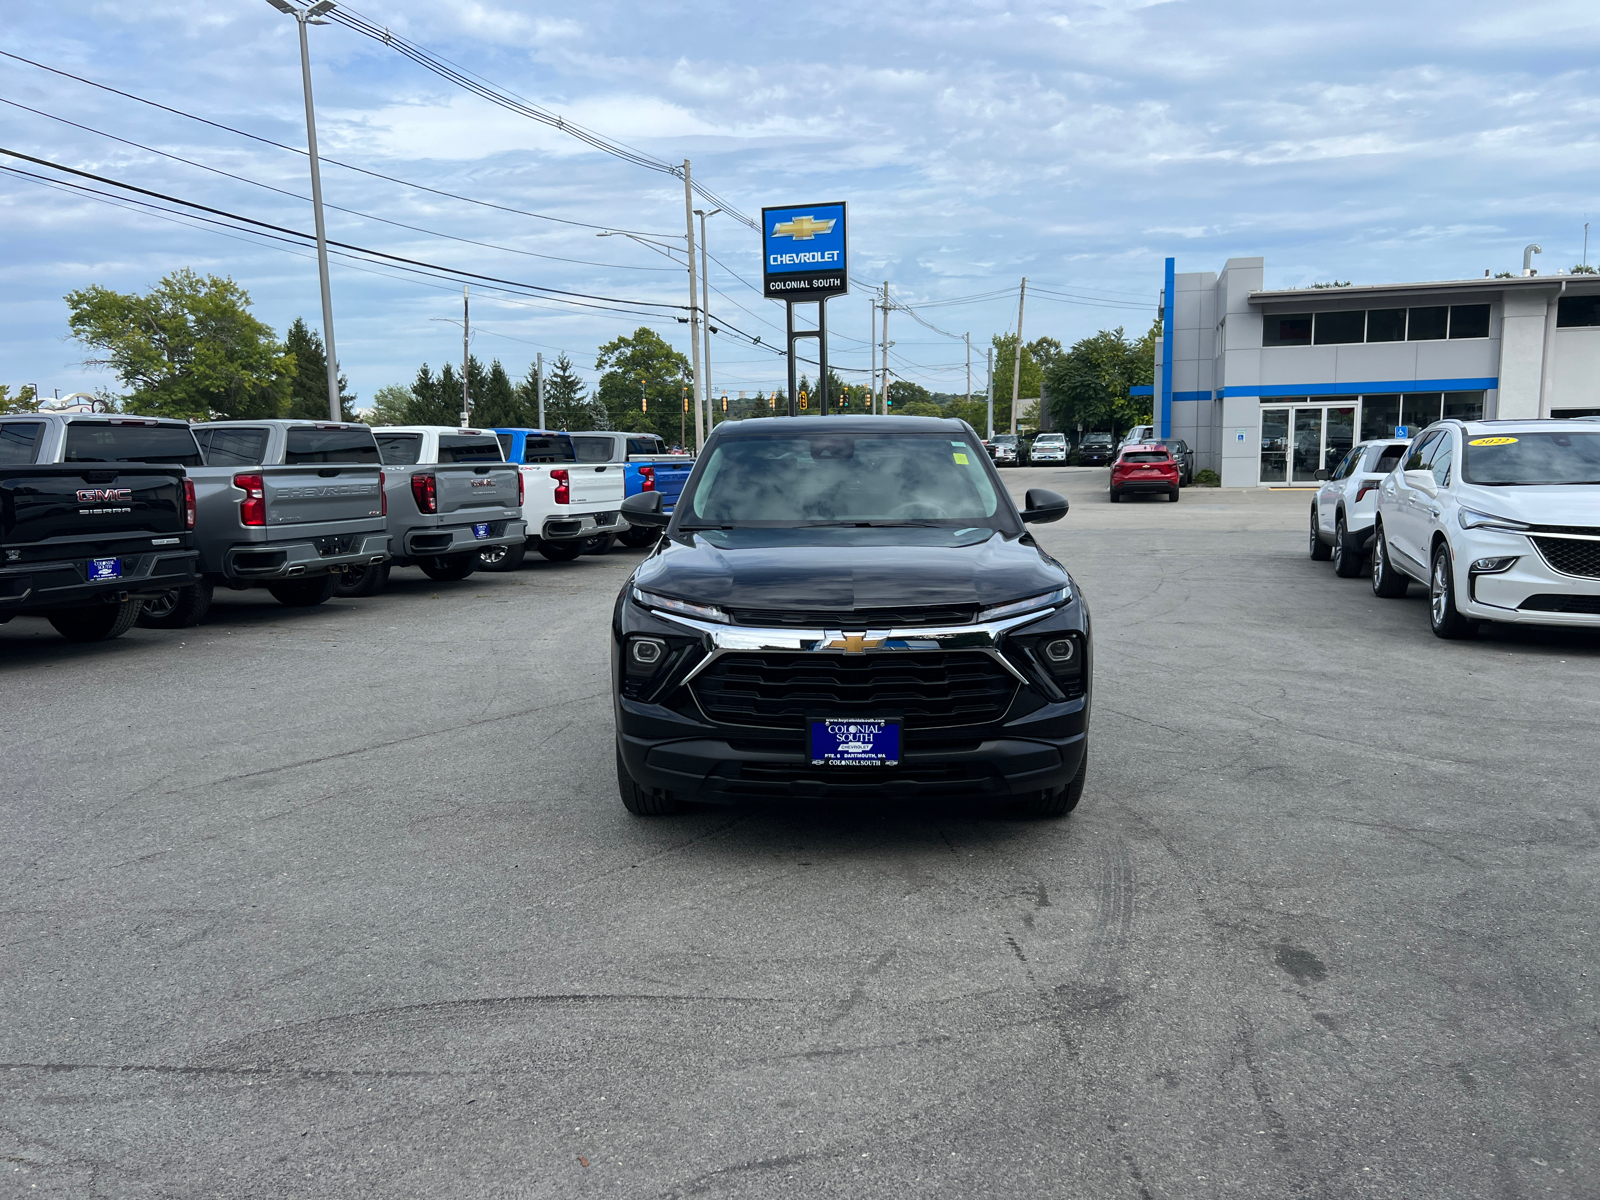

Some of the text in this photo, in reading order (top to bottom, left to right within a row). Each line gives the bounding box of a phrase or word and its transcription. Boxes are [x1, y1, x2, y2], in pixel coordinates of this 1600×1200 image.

[770, 251, 839, 265] CHEVROLET
[770, 279, 840, 290] COLONIAL SOUTH
[76, 488, 132, 503] GMC
[276, 484, 377, 499] CHEVROLET
[79, 507, 131, 515] SIERRA
[828, 725, 882, 734] COLONIAL
[836, 734, 874, 742] SOUTH
